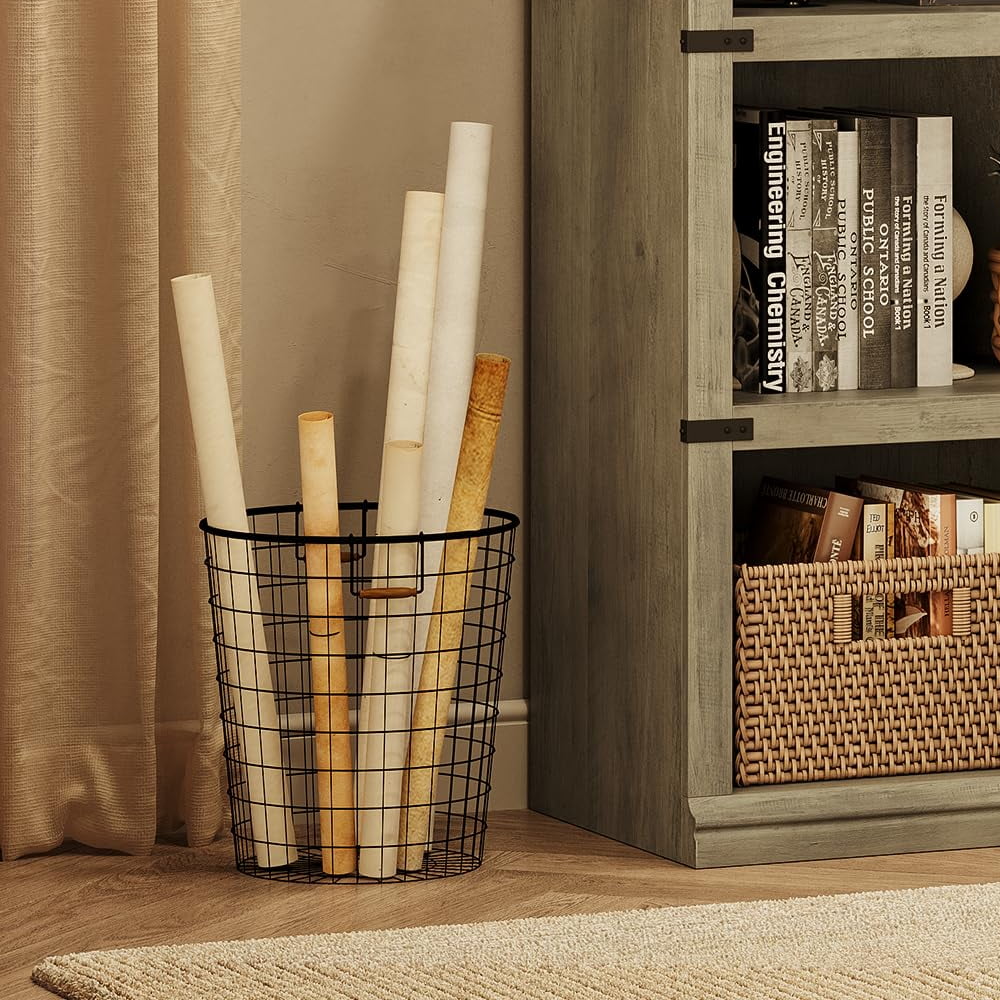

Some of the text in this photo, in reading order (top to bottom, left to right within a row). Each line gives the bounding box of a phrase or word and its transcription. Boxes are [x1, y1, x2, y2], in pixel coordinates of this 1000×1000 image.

[794, 159, 802, 202] HISTORY
[798, 141, 810, 221] PUBLIC SCHOOL
[819, 158, 828, 202] HISTORY
[824, 140, 836, 220] PUBLIC SCHOOL
[762, 122, 786, 393] Engineering Chemistry
[787, 251, 812, 321] ENGLAND
[813, 250, 837, 319] ENGLAND
[837, 198, 847, 342] PUBLIC SCHOOL
[849, 231, 858, 311] ONTARIO
[862, 188, 874, 339] PUBLIC SCHOOL
[879, 223, 889, 306] ONTARIO
[900, 195, 913, 330] Forming a Nation
[931, 194, 948, 329] Forming a Nation
[923, 305, 931, 323] Book
[787, 489, 828, 509] CHARLOTTE
[869, 513, 880, 523] TED
[873, 592, 885, 637] OF THE
